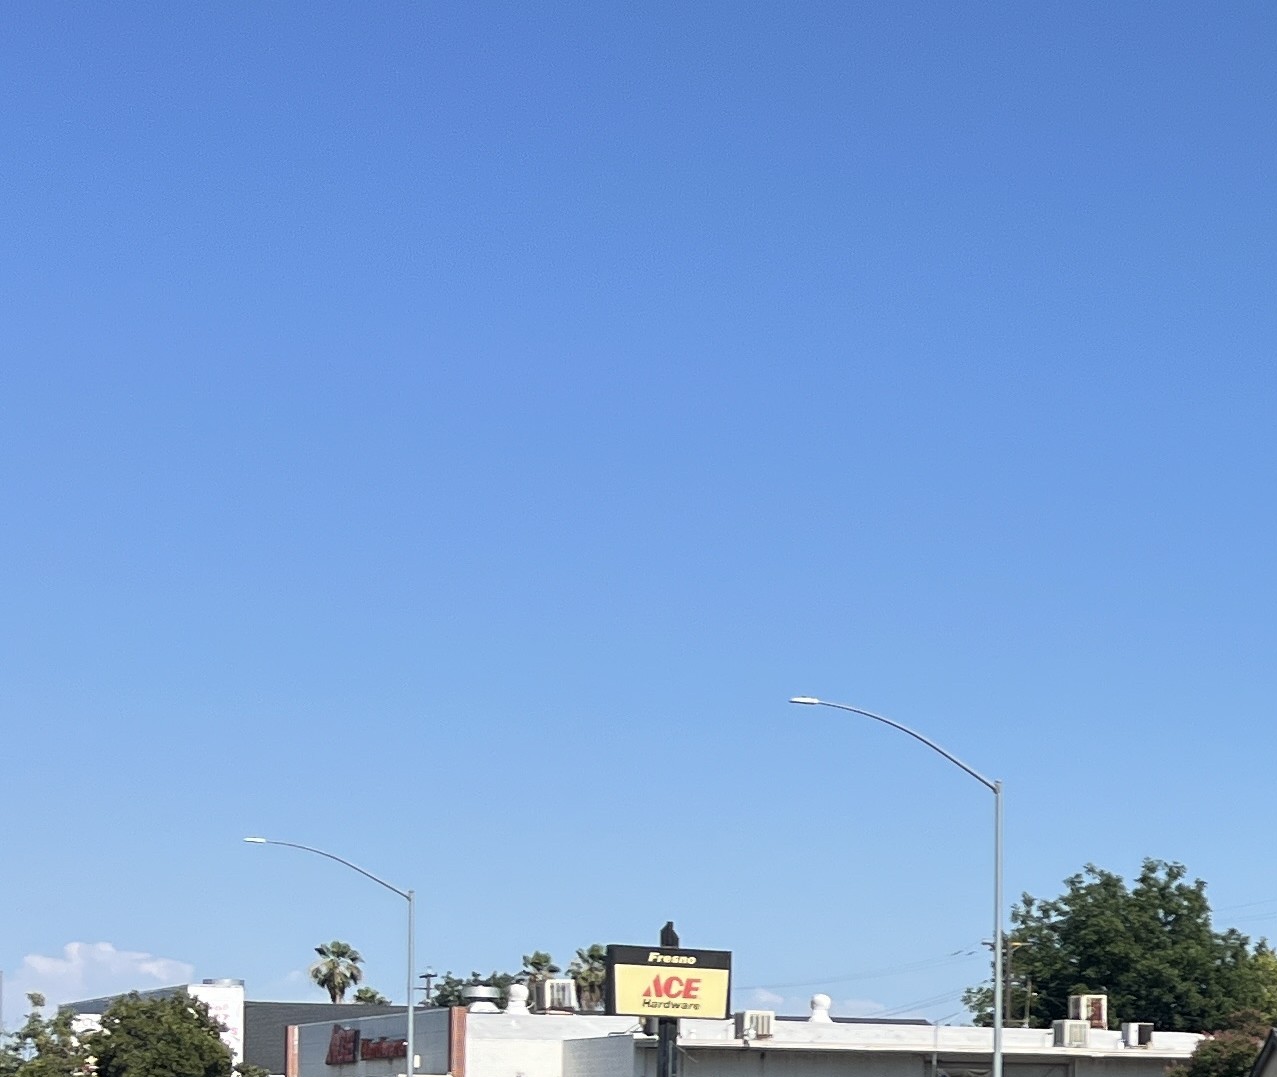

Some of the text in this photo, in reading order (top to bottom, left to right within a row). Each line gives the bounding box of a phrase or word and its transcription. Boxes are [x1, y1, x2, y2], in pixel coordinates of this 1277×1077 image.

[648, 951, 697, 965] Fresno
[642, 974, 702, 999] ACE
[642, 998, 701, 1011] Hardware
